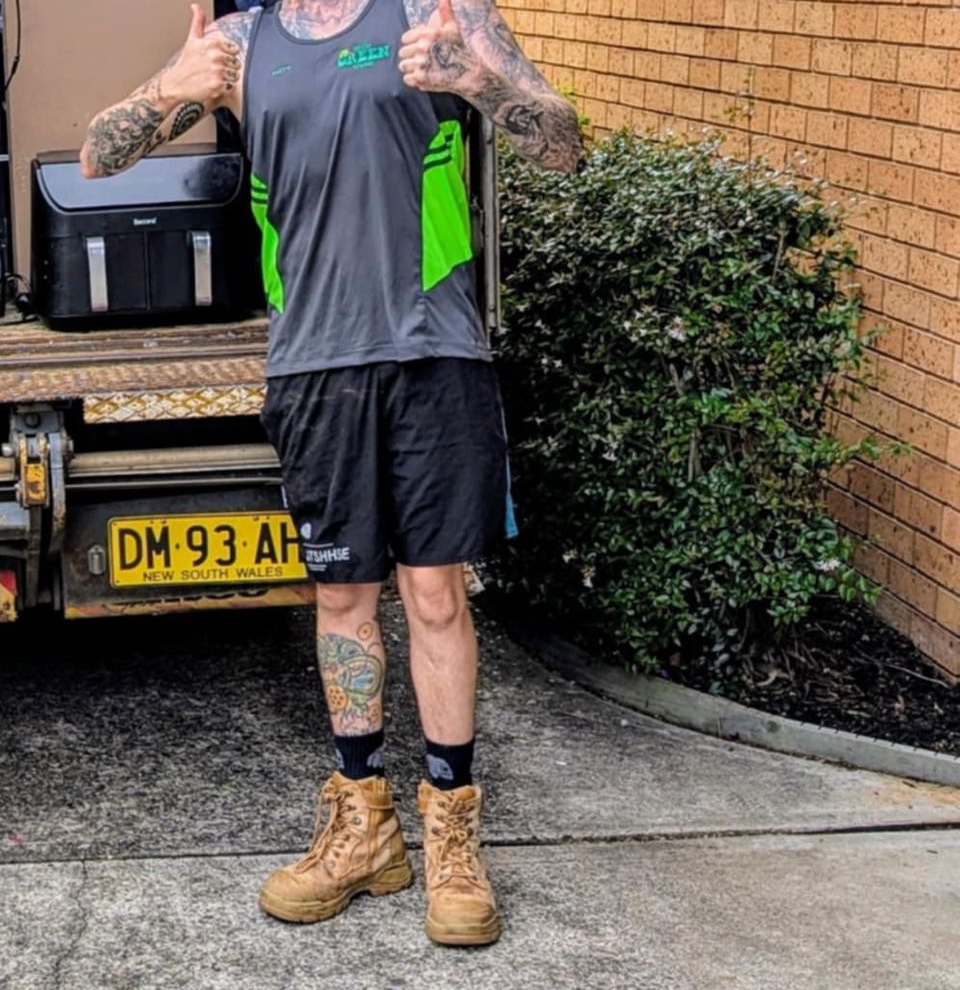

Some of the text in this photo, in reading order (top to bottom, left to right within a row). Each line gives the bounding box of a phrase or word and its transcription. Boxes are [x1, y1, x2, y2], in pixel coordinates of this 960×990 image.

[337, 44, 390, 68] GREEN
[143, 566, 283, 582] NEW SOUTH WALES
